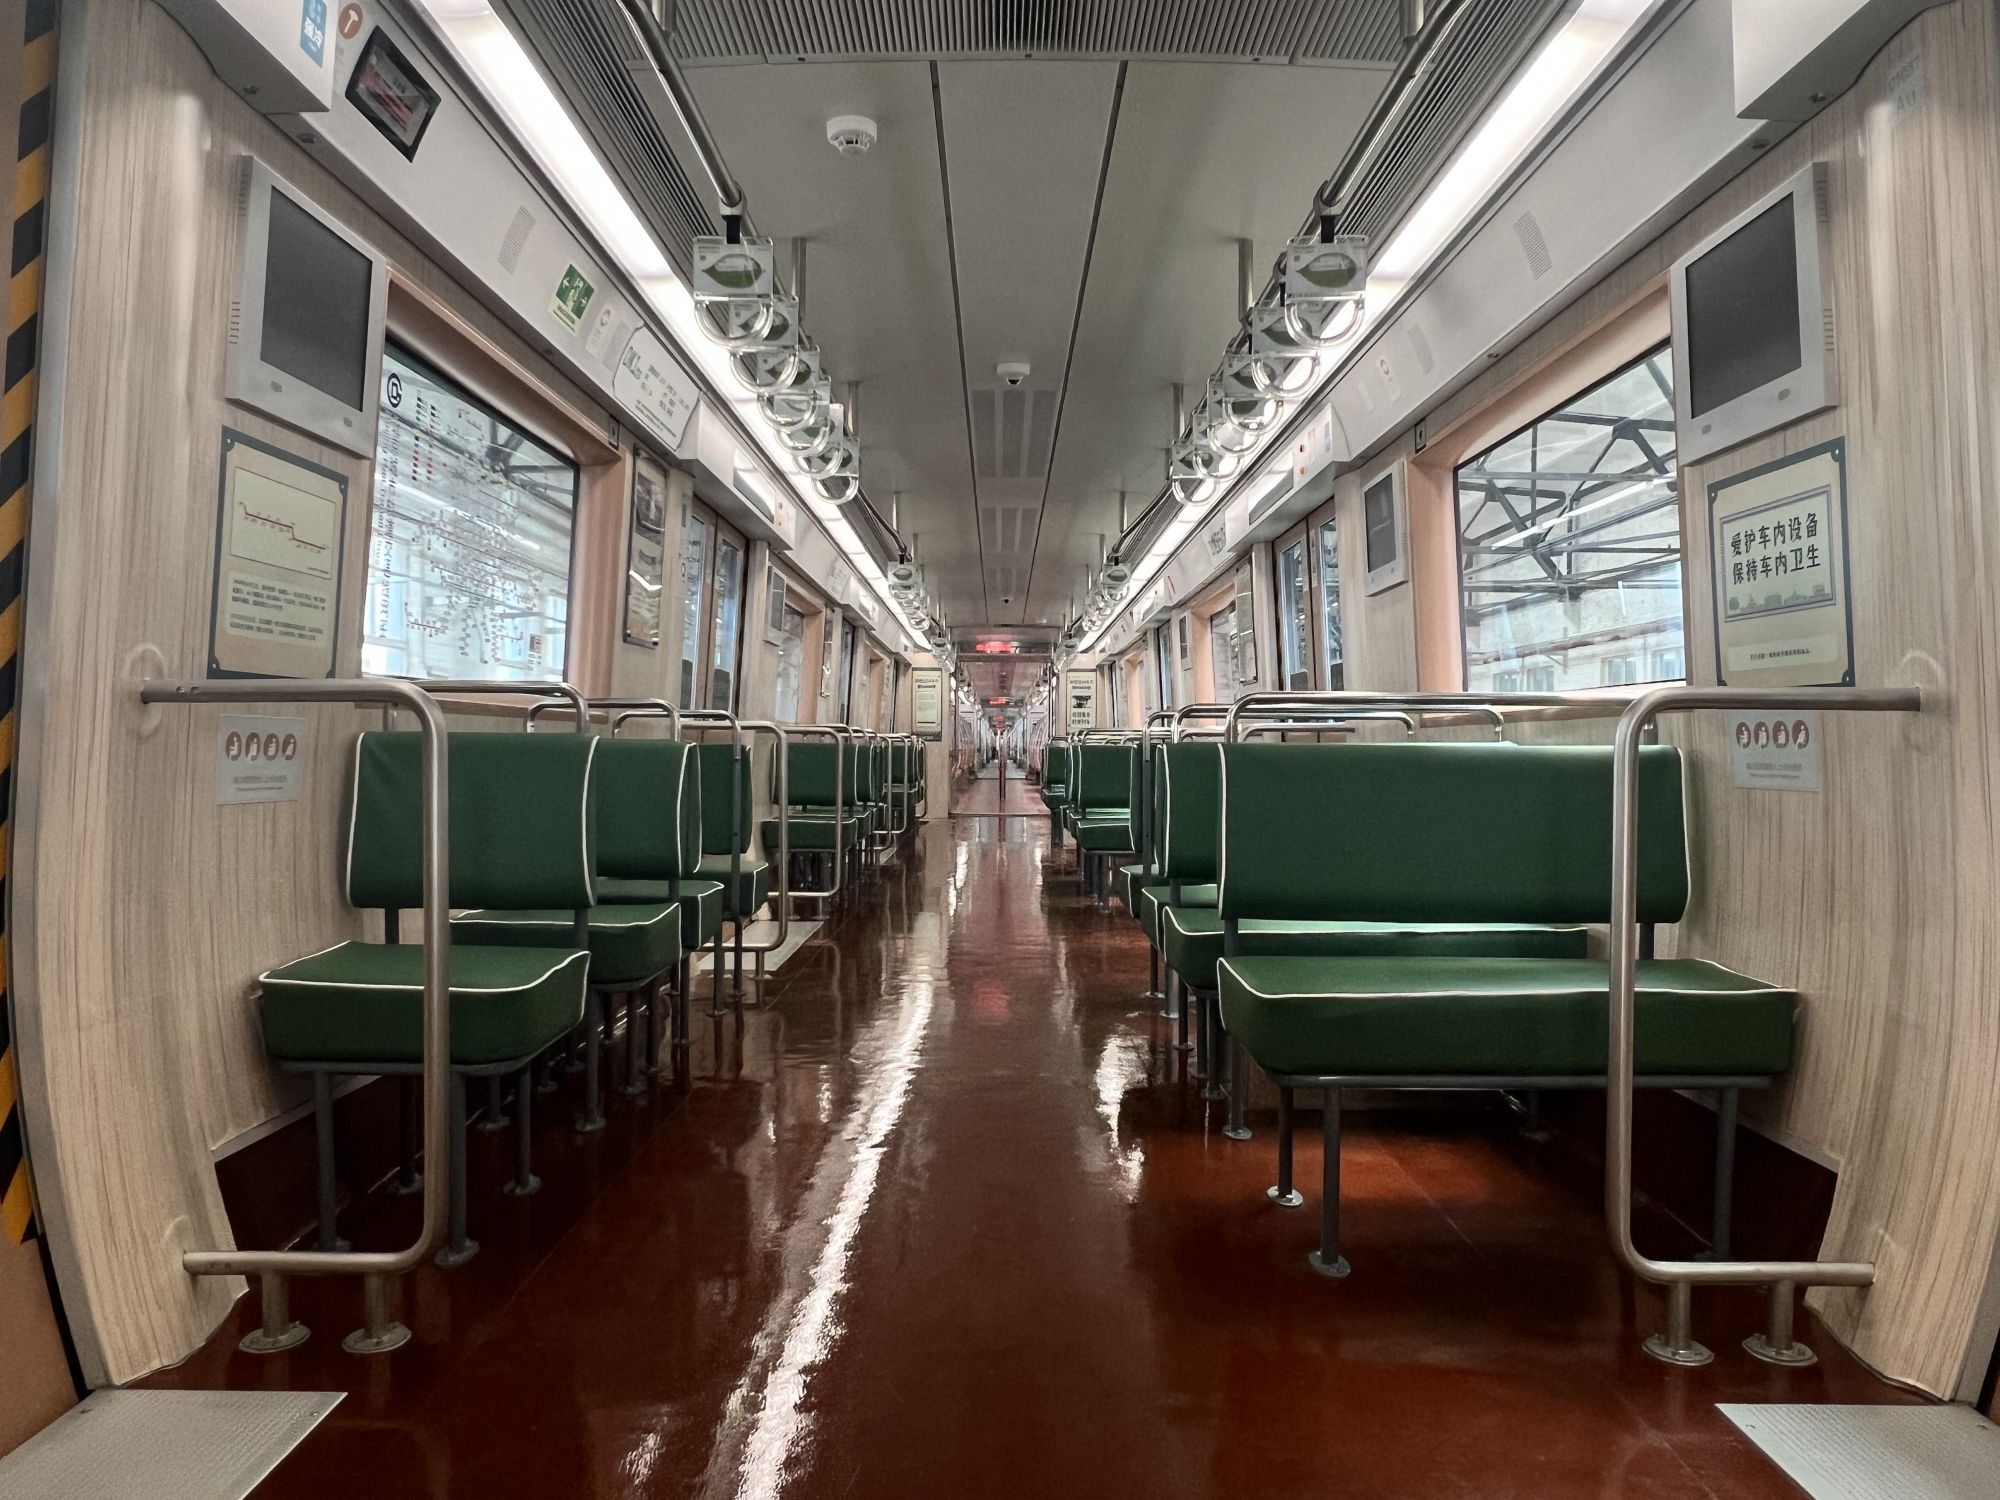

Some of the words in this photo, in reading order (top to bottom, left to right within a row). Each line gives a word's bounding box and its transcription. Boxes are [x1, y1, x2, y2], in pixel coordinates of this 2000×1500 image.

[1731, 512, 1818, 557] 爱护车内设备
[1733, 543, 1821, 585] 保持车内卫生
